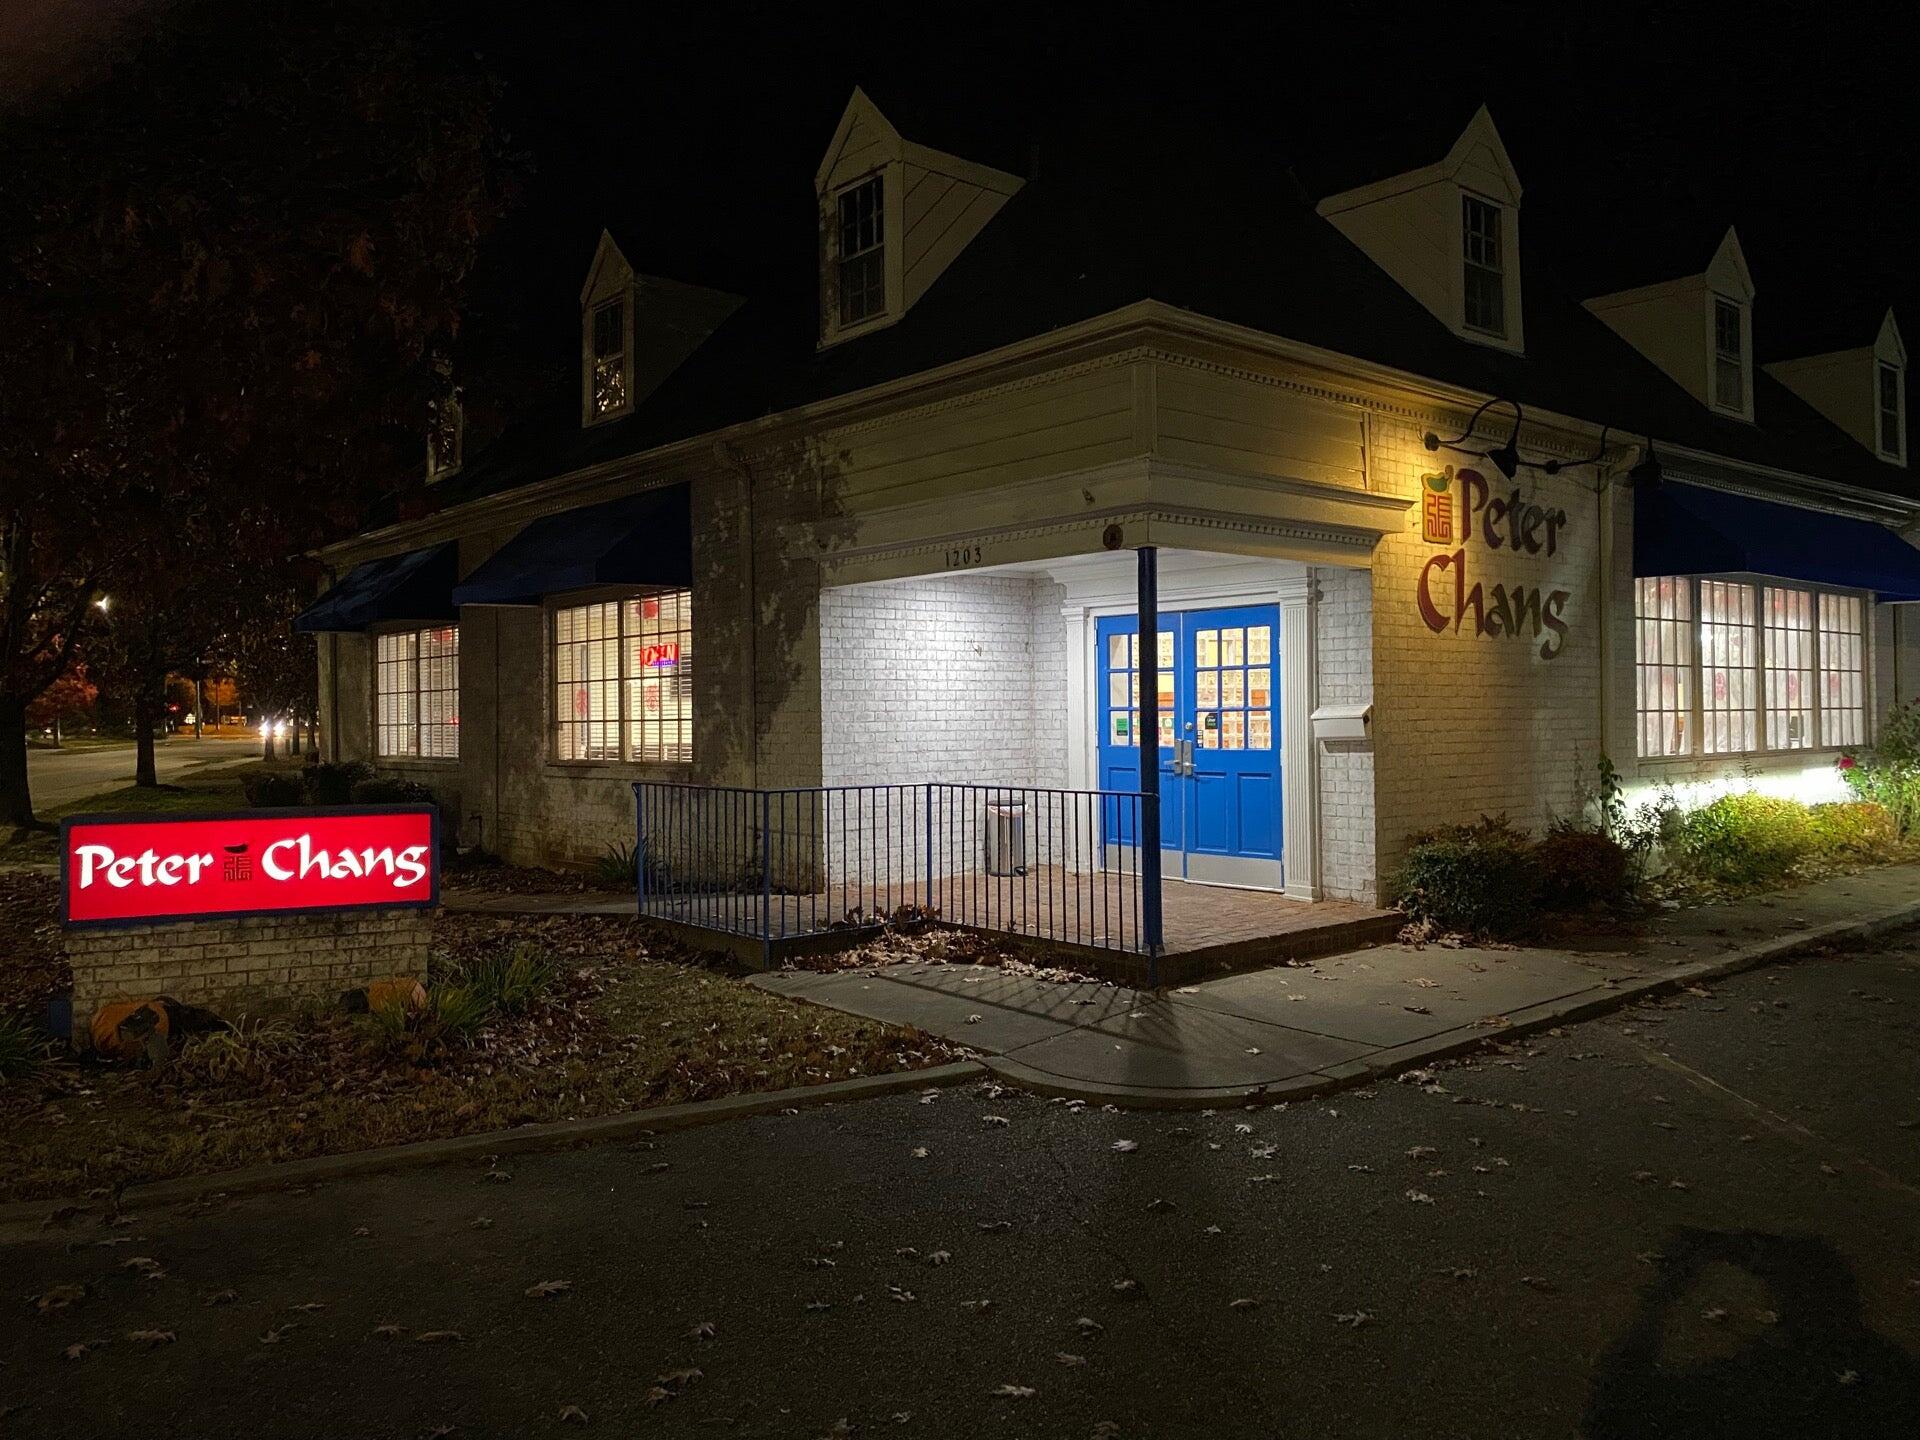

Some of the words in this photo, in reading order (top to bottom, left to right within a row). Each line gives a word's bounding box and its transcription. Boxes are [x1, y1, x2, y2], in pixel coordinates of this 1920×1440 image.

[1456, 468, 1567, 557] Peter
[945, 547, 982, 567] 1203
[1417, 548, 1571, 660] Chang
[75, 845, 212, 888] Peter
[261, 833, 428, 888] Chang
